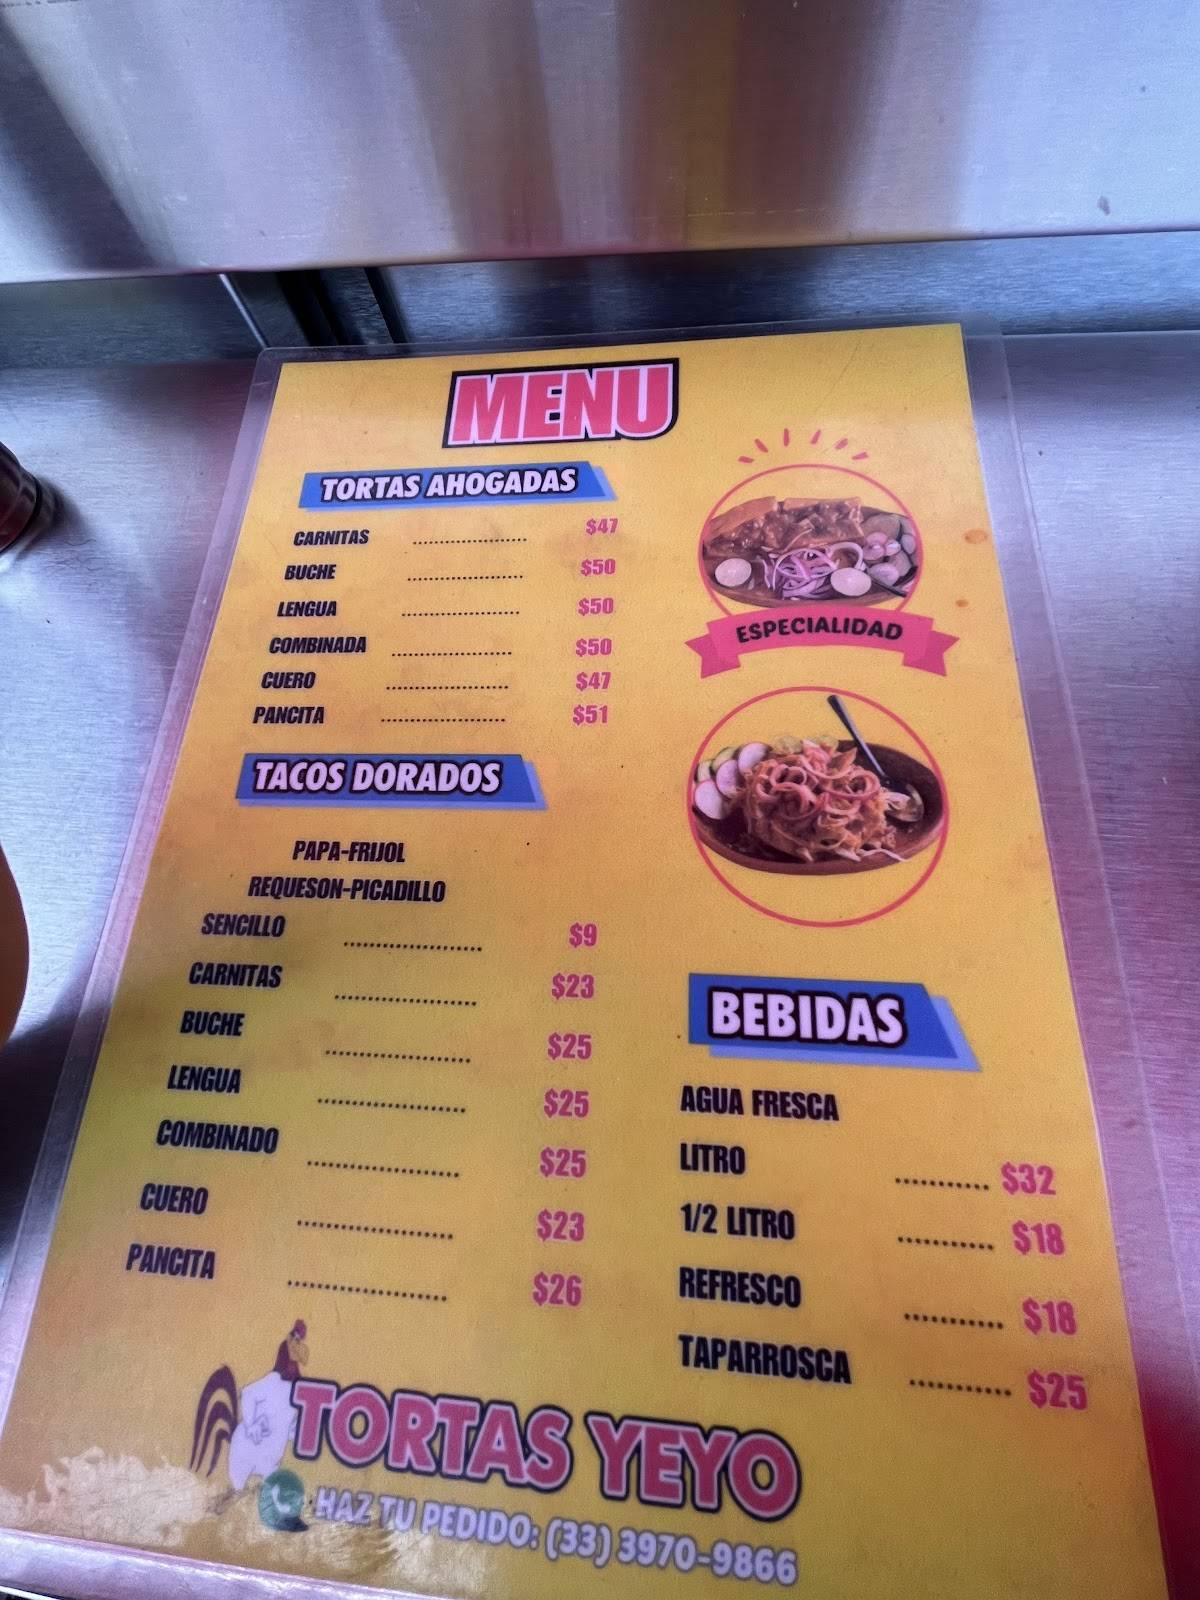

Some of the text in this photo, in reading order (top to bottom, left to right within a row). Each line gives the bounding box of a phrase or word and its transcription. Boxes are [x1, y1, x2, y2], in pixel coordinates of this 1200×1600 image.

[448, 364, 674, 446] MENU
[321, 469, 576, 501] TORTAS AHOGADAS
[294, 518, 618, 546] CARNITAS $47
[284, 559, 616, 580] BUCHE $50
[277, 598, 614, 617] LENGUA $50
[269, 637, 612, 656] COMBINADA $50
[736, 617, 902, 643] ESPECIALIDAD
[261, 672, 611, 691] CUERO $47
[253, 705, 607, 724] PANCITA $51
[253, 761, 501, 793] TACOS DORADOS
[293, 841, 405, 863] PAPA-FRIJOL
[248, 877, 446, 902] REQUESON-PICADILLO
[201, 913, 597, 947] SENCILLO $9
[189, 962, 595, 1000] CARNITAS $23
[180, 1011, 592, 1060] BUCHE $25
[712, 991, 903, 1044] BEBIDAS
[167, 1065, 589, 1118] LENGUA $25
[681, 1085, 839, 1121] AGUA FRESCA
[156, 1120, 586, 1178] COMBINADO $25
[681, 1143, 1056, 1195] LITRO $32
[140, 1183, 585, 1242] CUERO $23
[681, 1203, 1065, 1255] 1/2 LITRO $18
[126, 1244, 582, 1307] PANCITA $26
[680, 1267, 1077, 1335] REFRESCO $18
[679, 1335, 1088, 1409] TAPARROSCA $25
[290, 1380, 801, 1520] TORTAS YEYO
[315, 1487, 797, 1585] HAZ TU PEDIDO: (33) 3970-9866
